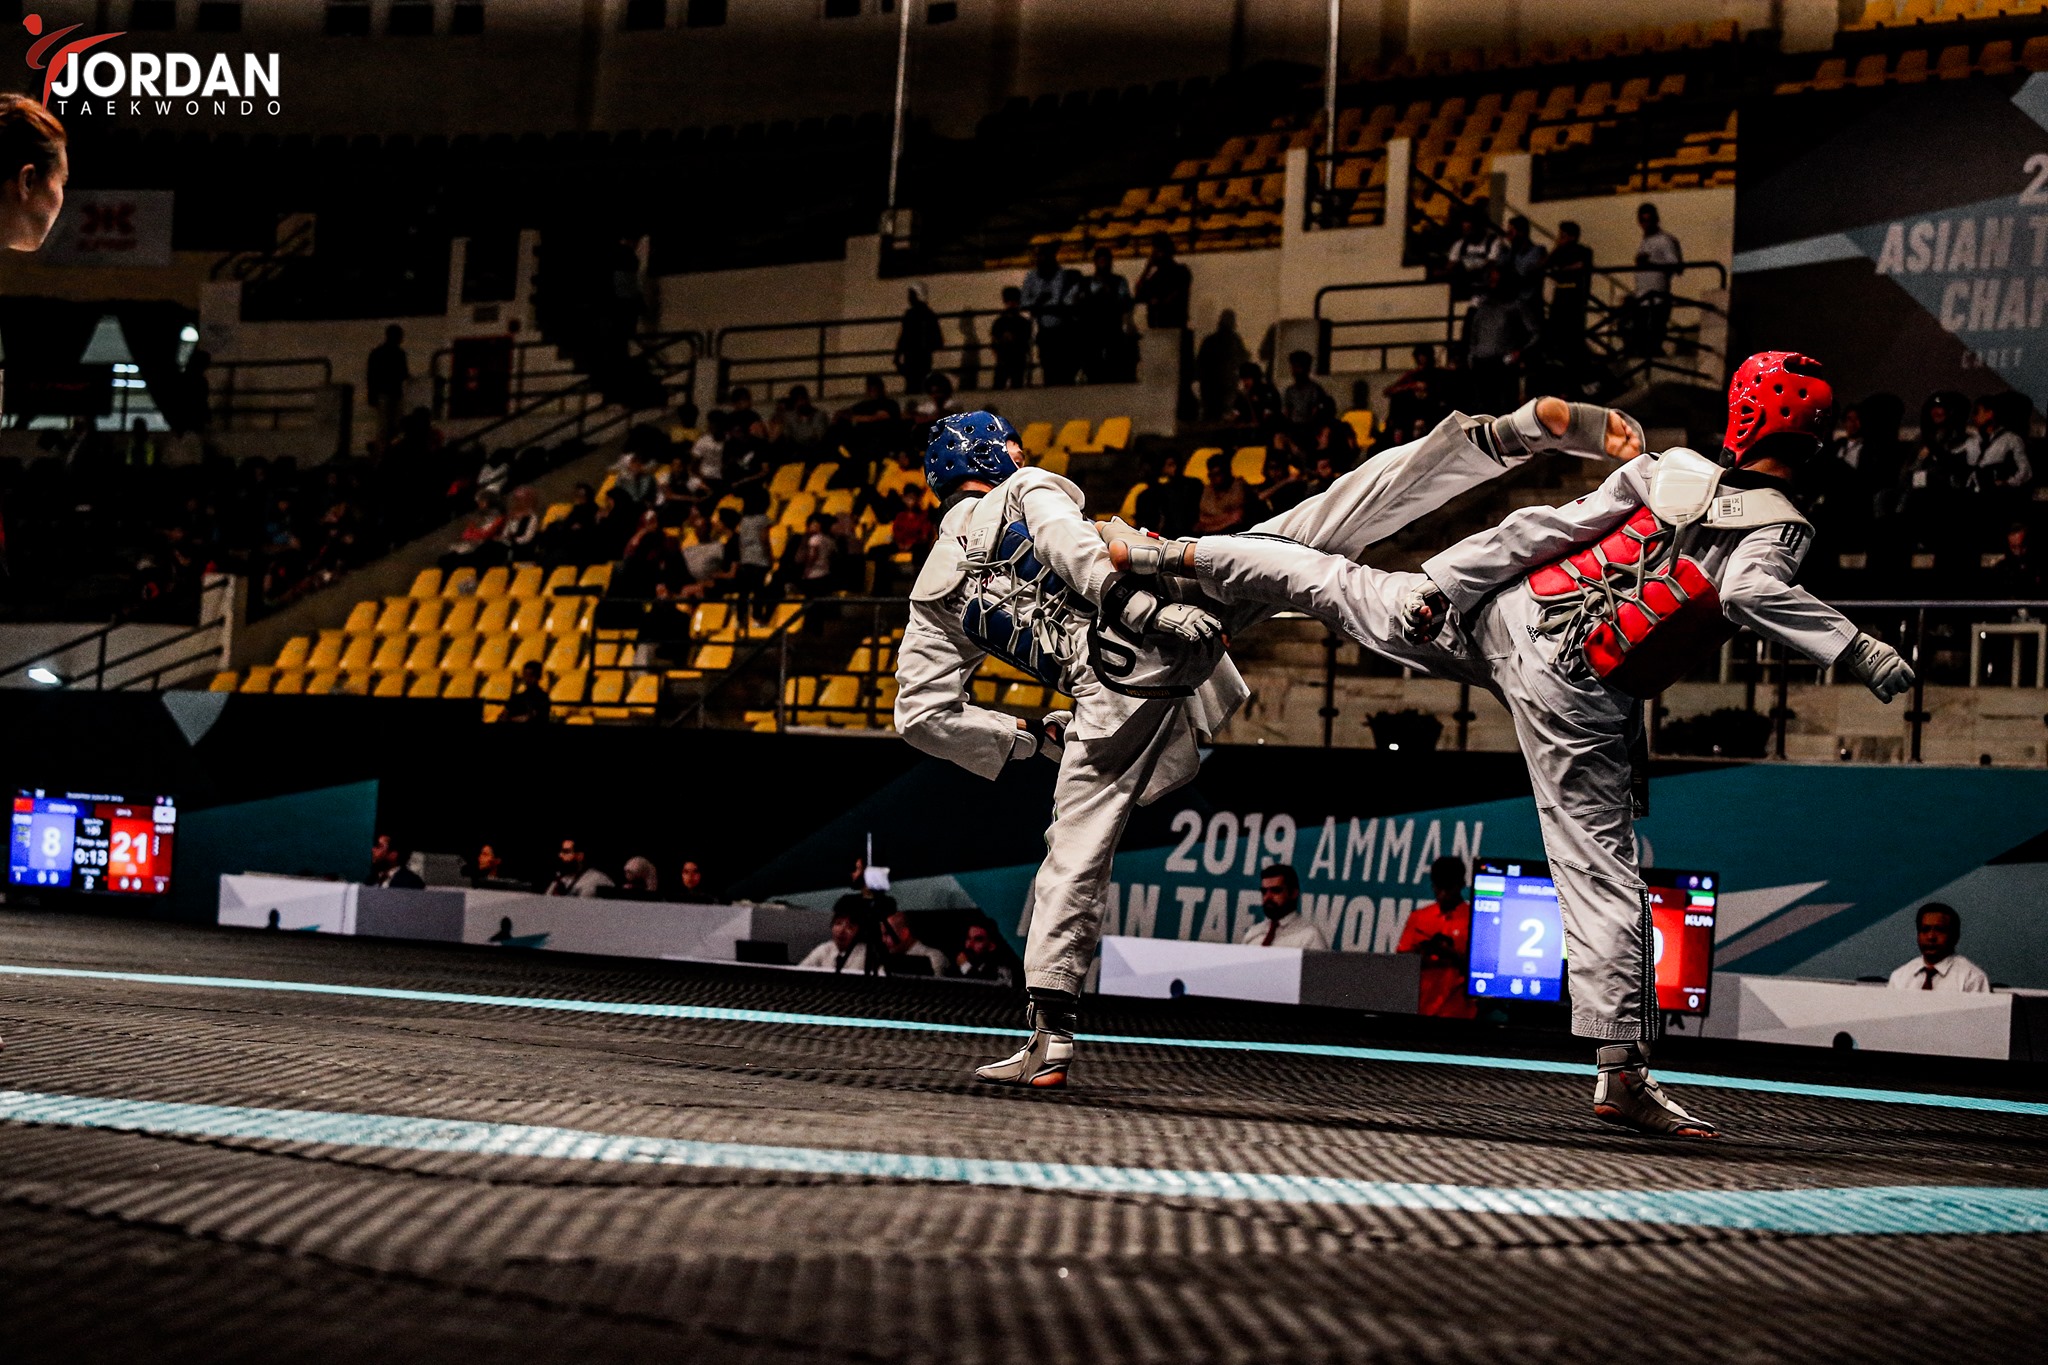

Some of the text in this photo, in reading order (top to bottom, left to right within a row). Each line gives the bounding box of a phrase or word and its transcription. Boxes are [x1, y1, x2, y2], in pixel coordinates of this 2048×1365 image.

[1874, 218, 2014, 275] ASIAN
[41, 826, 61, 858] 8
[74, 847, 108, 867] 0:13
[110, 831, 148, 864] 21
[1165, 808, 1484, 888] 2019 AMMAN
[1517, 918, 1546, 958] 2
[1688, 994, 1699, 1009] 0
